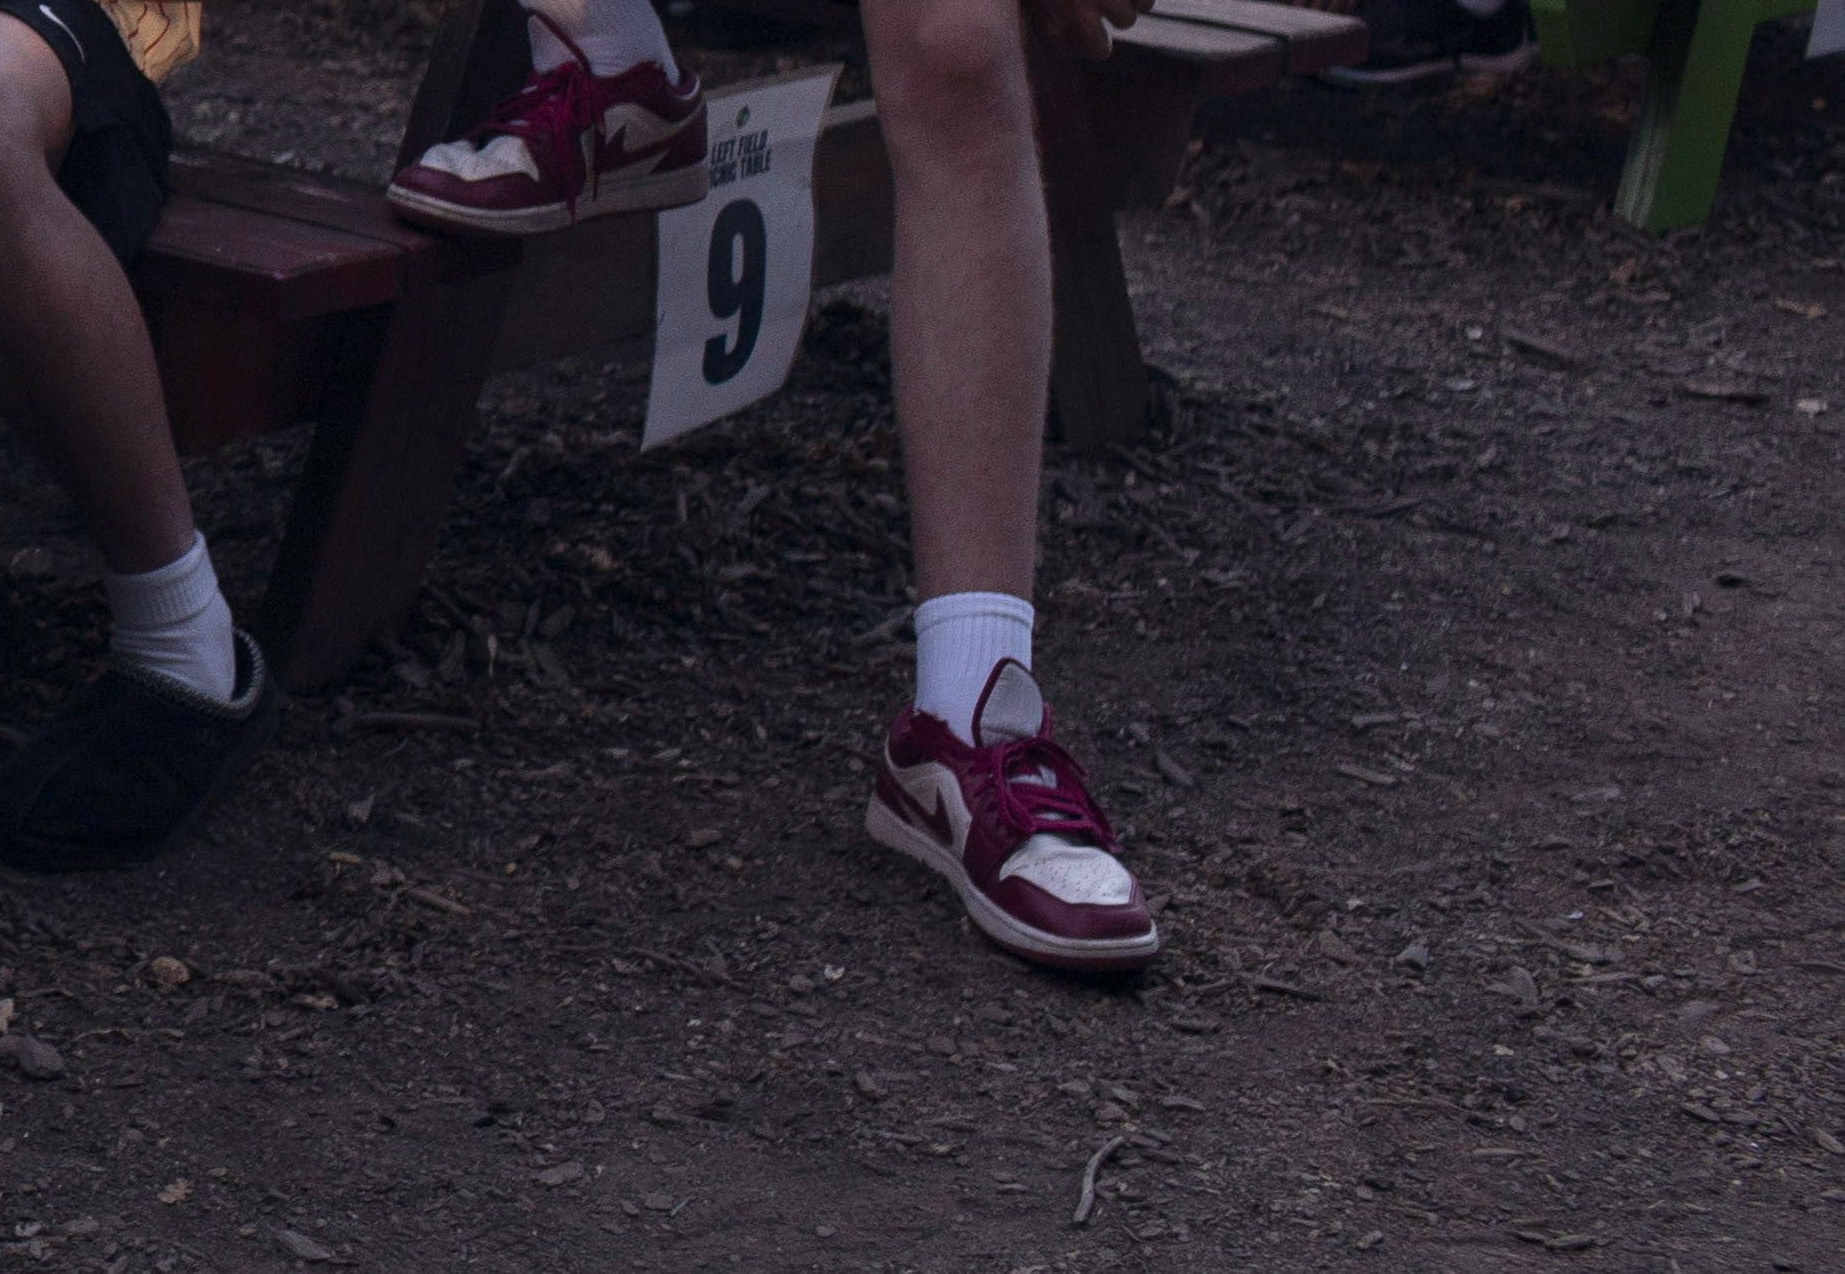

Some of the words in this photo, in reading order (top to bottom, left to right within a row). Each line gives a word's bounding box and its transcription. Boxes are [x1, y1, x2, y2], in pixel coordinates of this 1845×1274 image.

[711, 139, 737, 165] LEFT
[737, 129, 769, 157] FIELD
[709, 162, 737, 190] ICNIC
[740, 149, 772, 179] TABLE
[702, 199, 767, 385] 9
